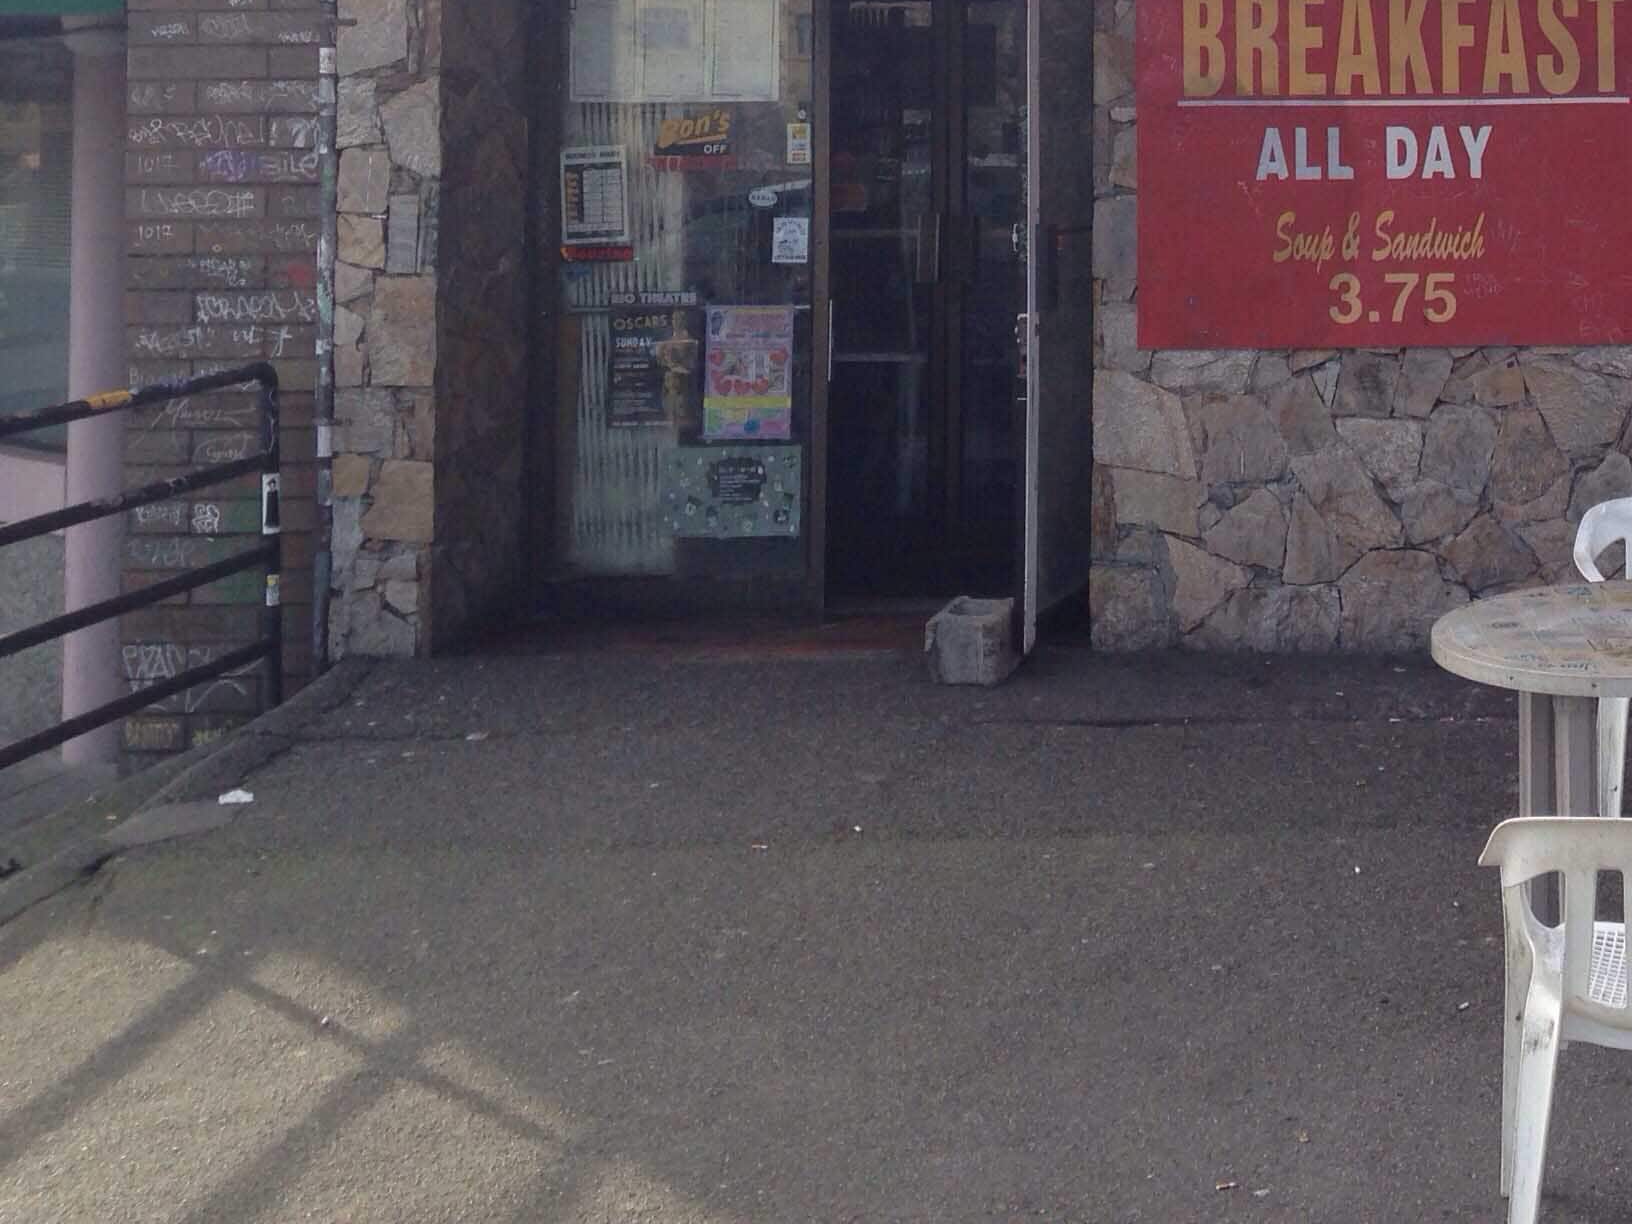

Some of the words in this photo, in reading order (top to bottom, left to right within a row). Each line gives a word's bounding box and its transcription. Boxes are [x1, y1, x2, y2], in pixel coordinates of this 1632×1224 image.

[703, 143, 727, 155] OFF
[1255, 126, 1355, 181] ALL
[1385, 125, 1493, 180] DAY
[1272, 212, 1335, 272] Soup
[1342, 212, 1360, 260] &
[1372, 211, 1486, 261] Sandwich
[613, 314, 668, 331] OSCARS
[1328, 272, 1458, 324] 3.75
